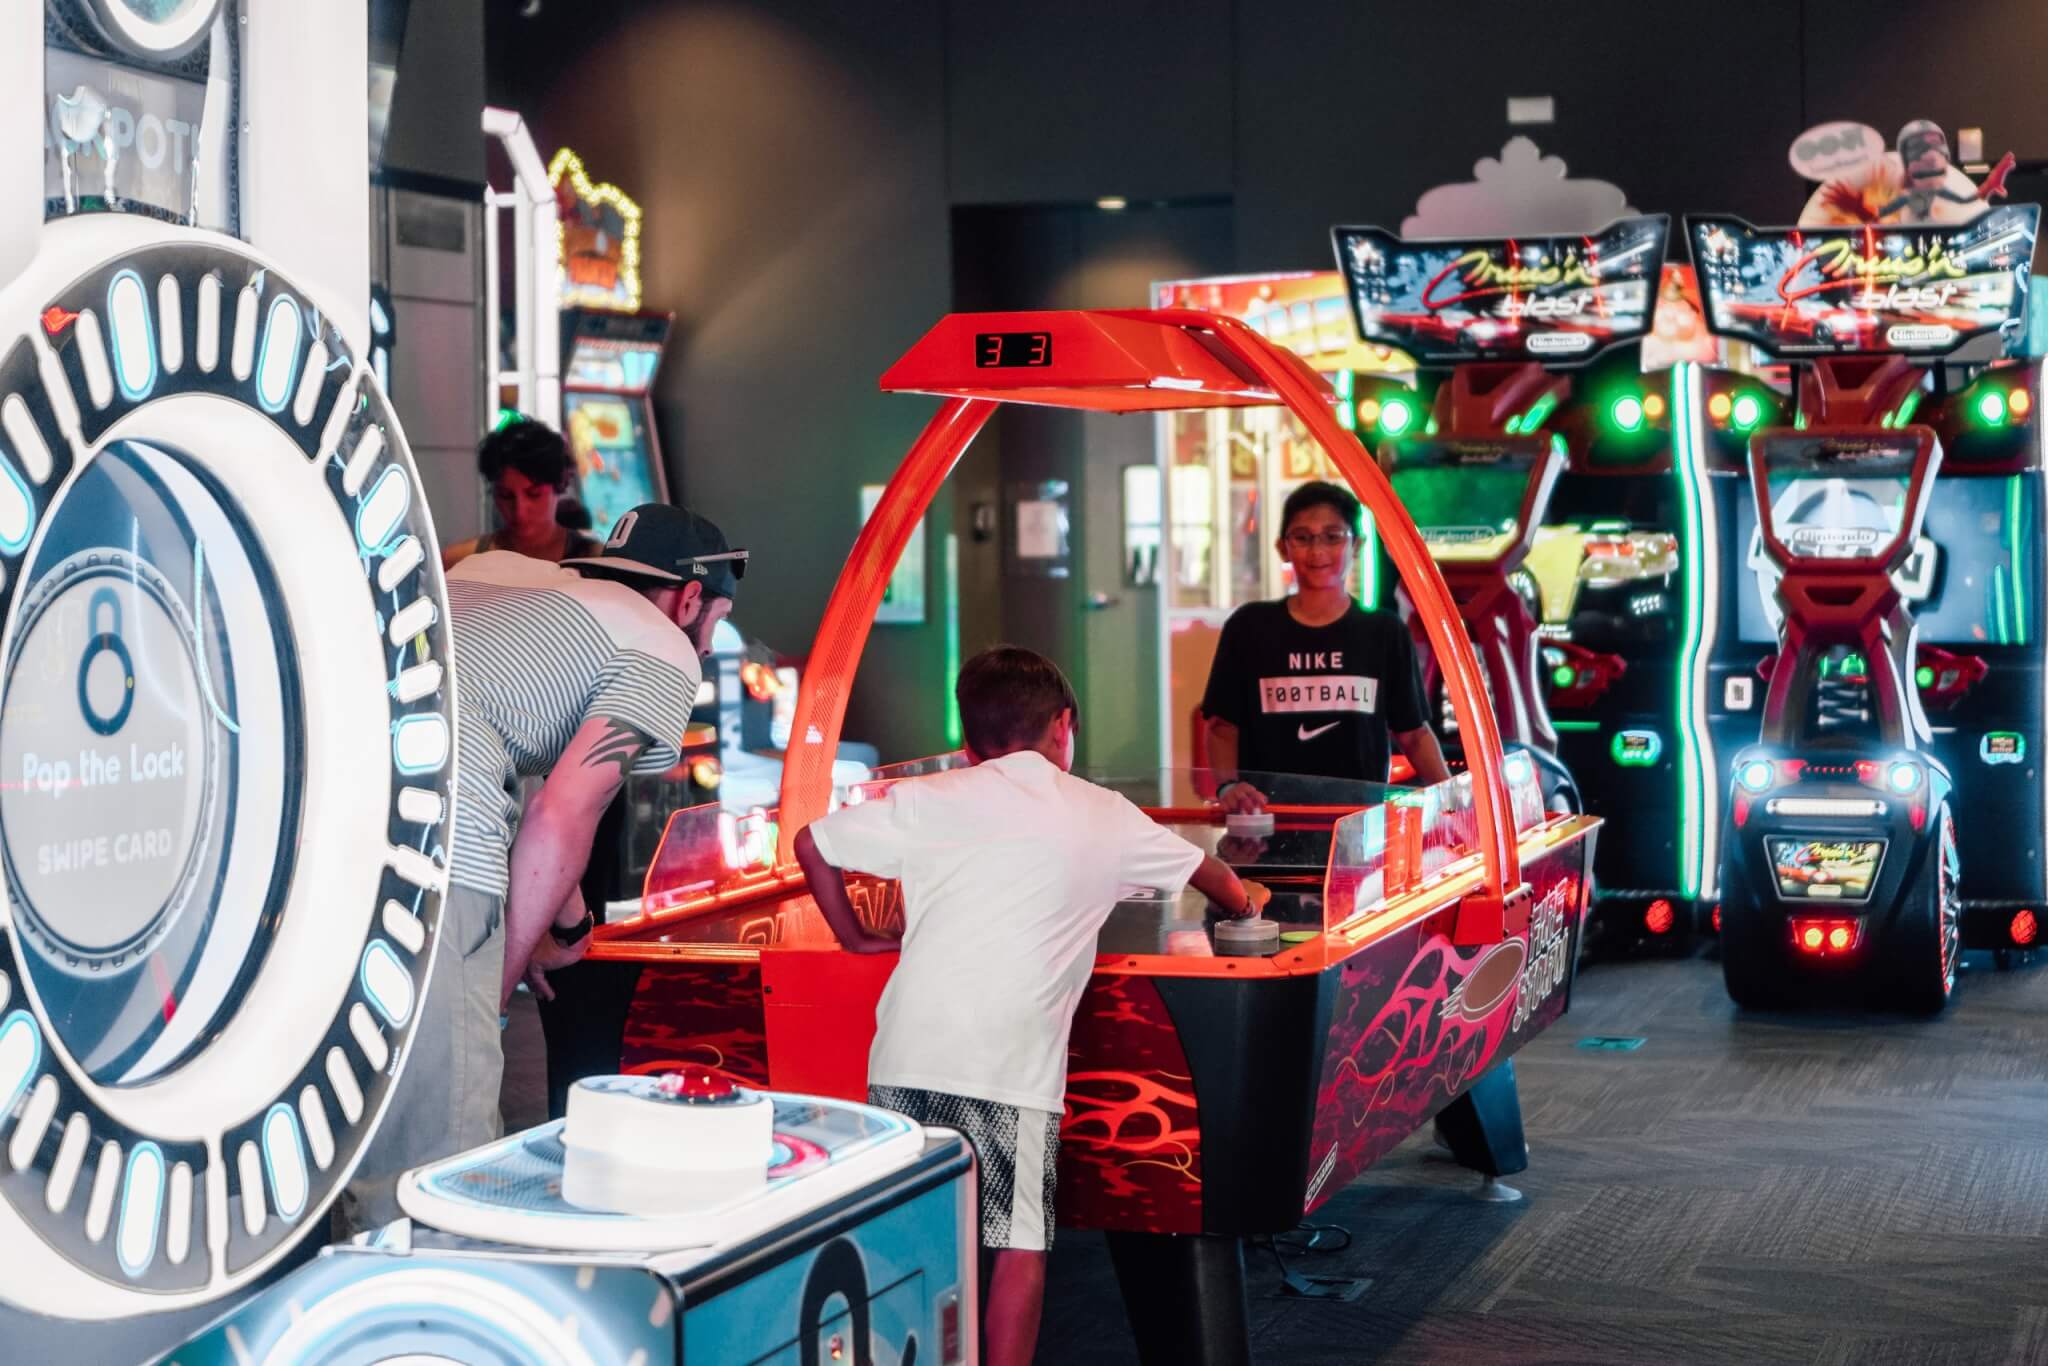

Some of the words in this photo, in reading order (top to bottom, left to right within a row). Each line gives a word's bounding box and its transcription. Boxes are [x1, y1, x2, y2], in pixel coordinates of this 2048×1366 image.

[1498, 290, 1593, 317] blast
[1856, 282, 1958, 309] blast
[984, 336, 1002, 366] 3
[1028, 335, 1046, 364] 3
[1797, 528, 1873, 543] Nintendo
[1288, 652, 1343, 669] NIKE
[22, 752, 72, 798] Pop
[79, 748, 121, 786] the
[130, 741, 184, 782] Lock
[37, 836, 109, 875] SWIPE
[113, 828, 172, 864] CARD
